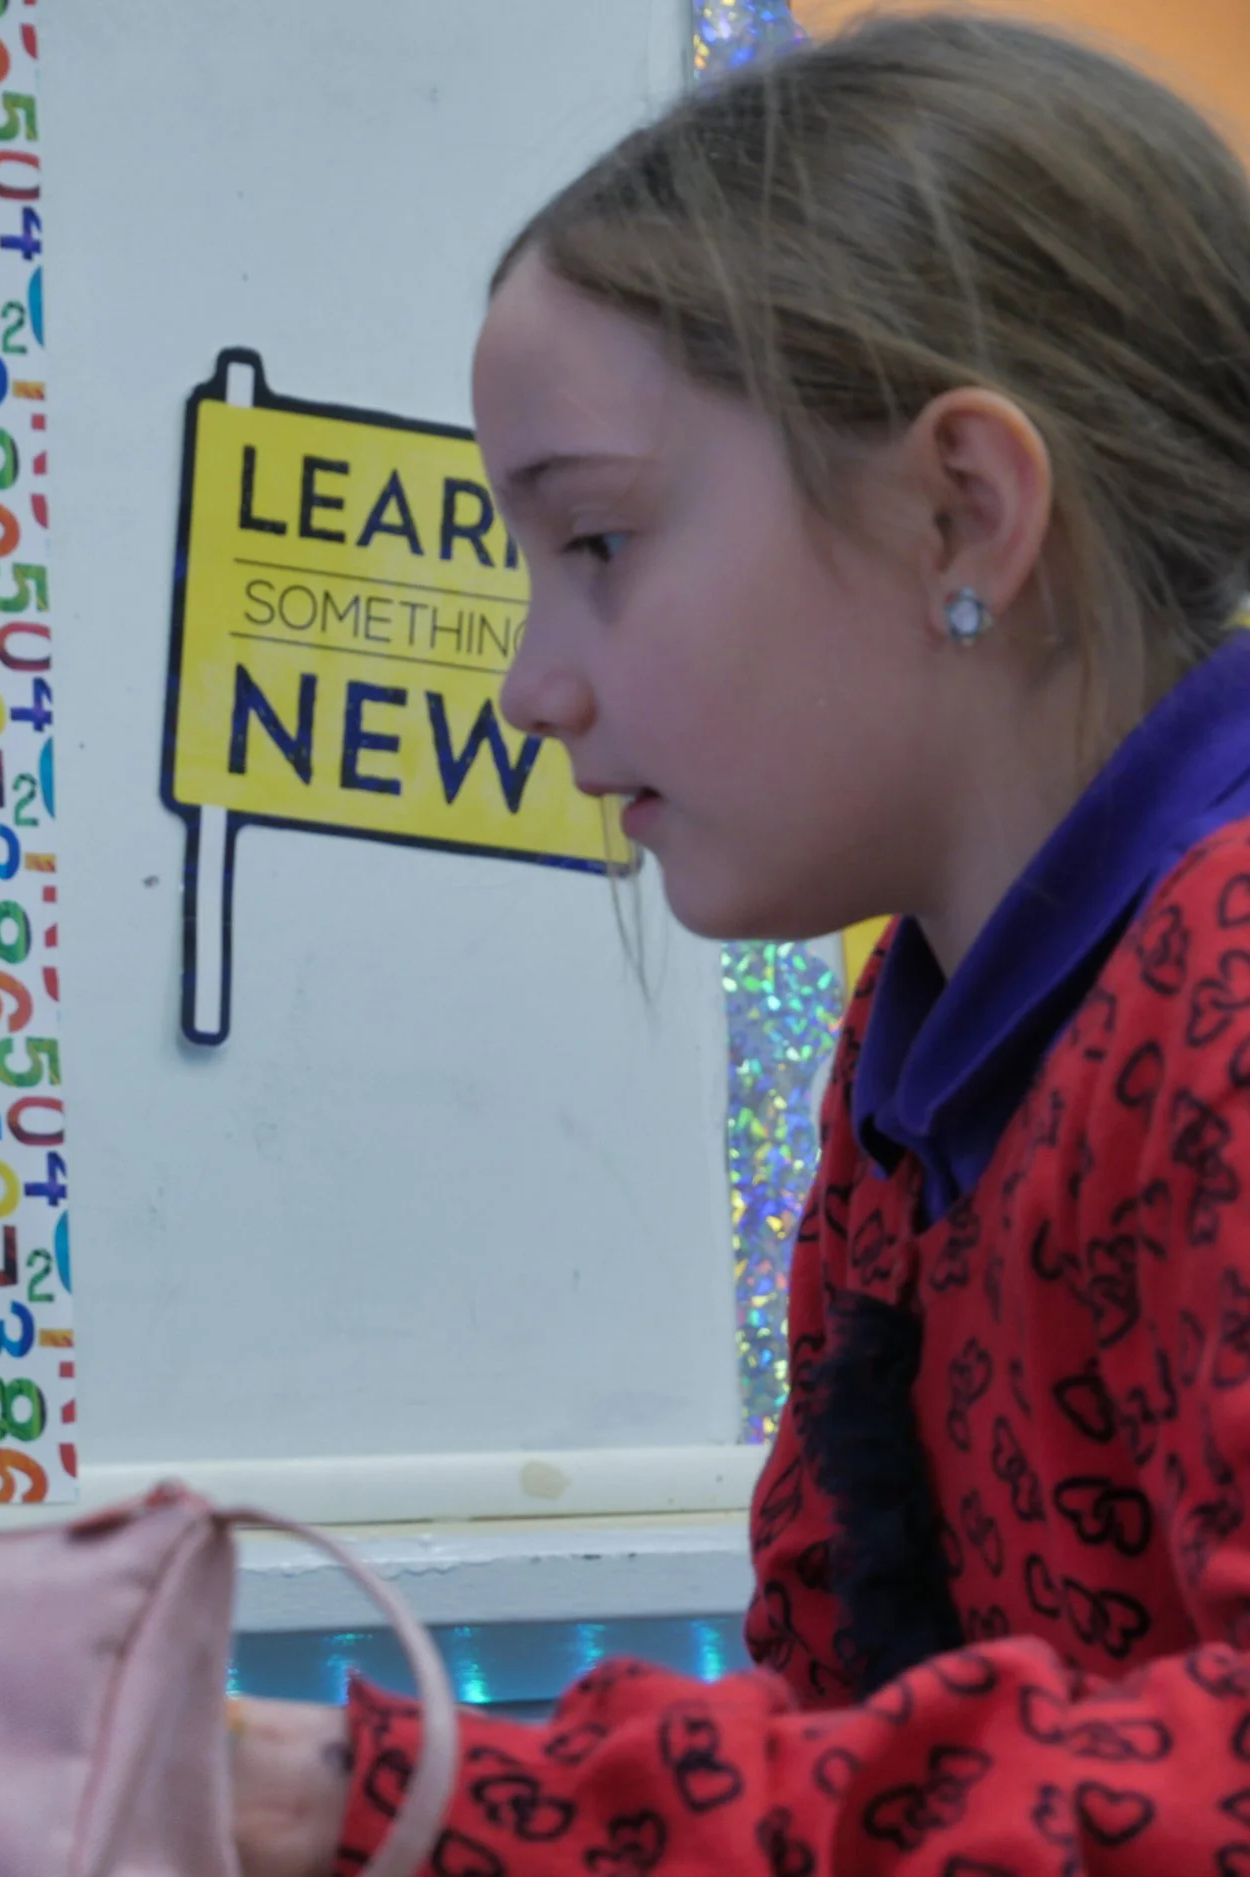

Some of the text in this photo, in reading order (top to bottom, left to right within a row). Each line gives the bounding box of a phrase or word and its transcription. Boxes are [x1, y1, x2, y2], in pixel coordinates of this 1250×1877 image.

[1, 300, 27, 355] 2
[243, 579, 528, 659] SOMETHIN
[227, 662, 543, 815] NEW
[13, 773, 39, 827] 2
[26, 1248, 54, 1302] 2
